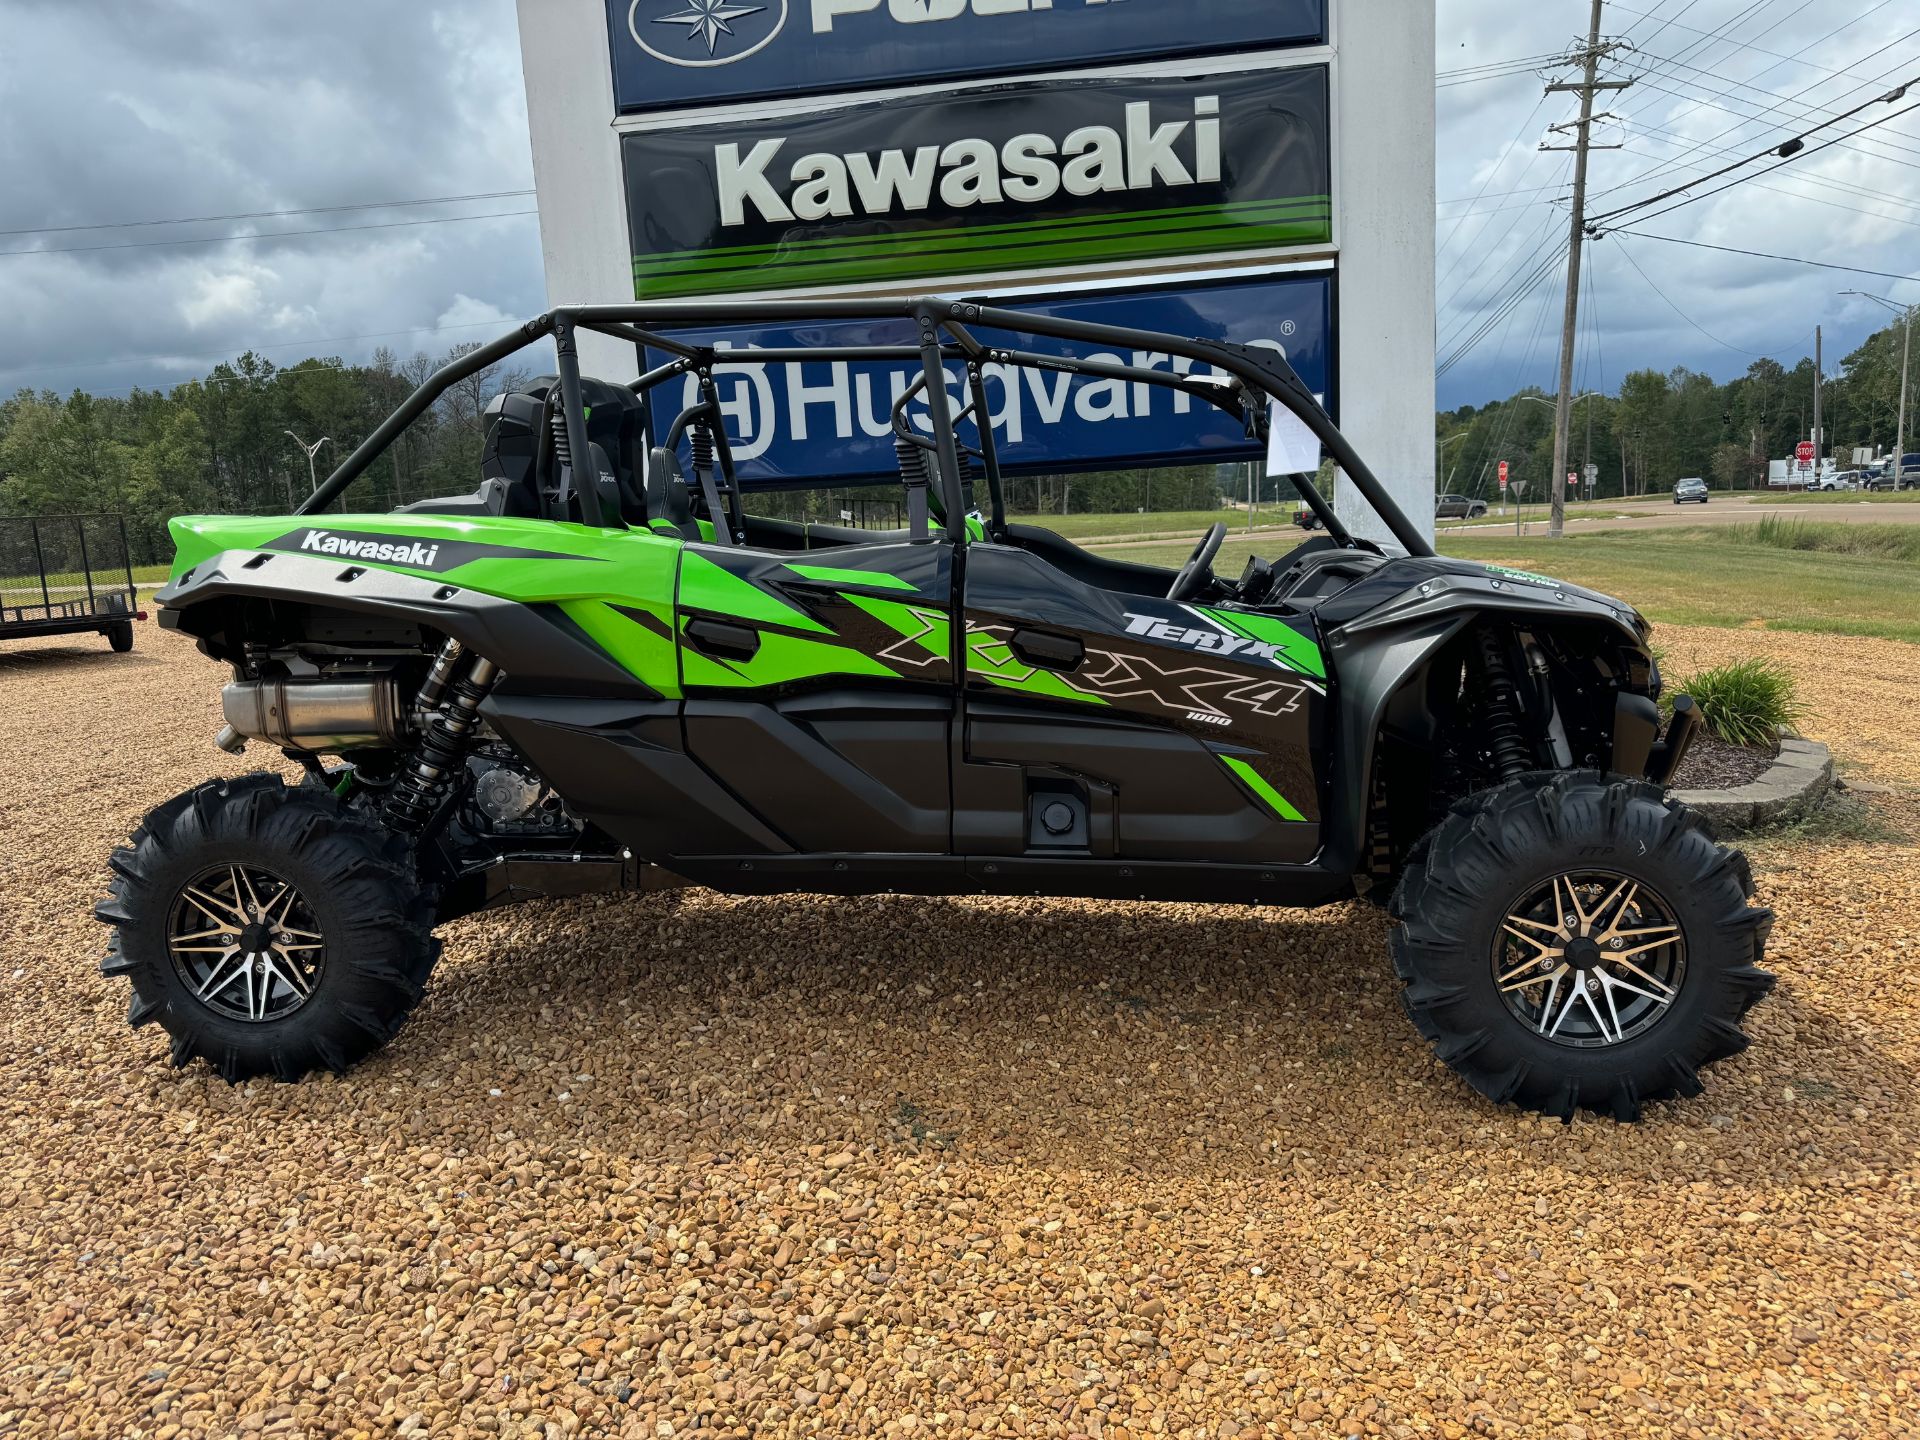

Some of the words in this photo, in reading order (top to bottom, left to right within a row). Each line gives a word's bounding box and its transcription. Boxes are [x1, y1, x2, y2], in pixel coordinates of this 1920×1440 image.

[714, 95, 1220, 226] Kawasaki
[1797, 447, 1814, 456] STOP
[301, 530, 439, 566] Kawasaki
[1185, 711, 1233, 726] 1000
